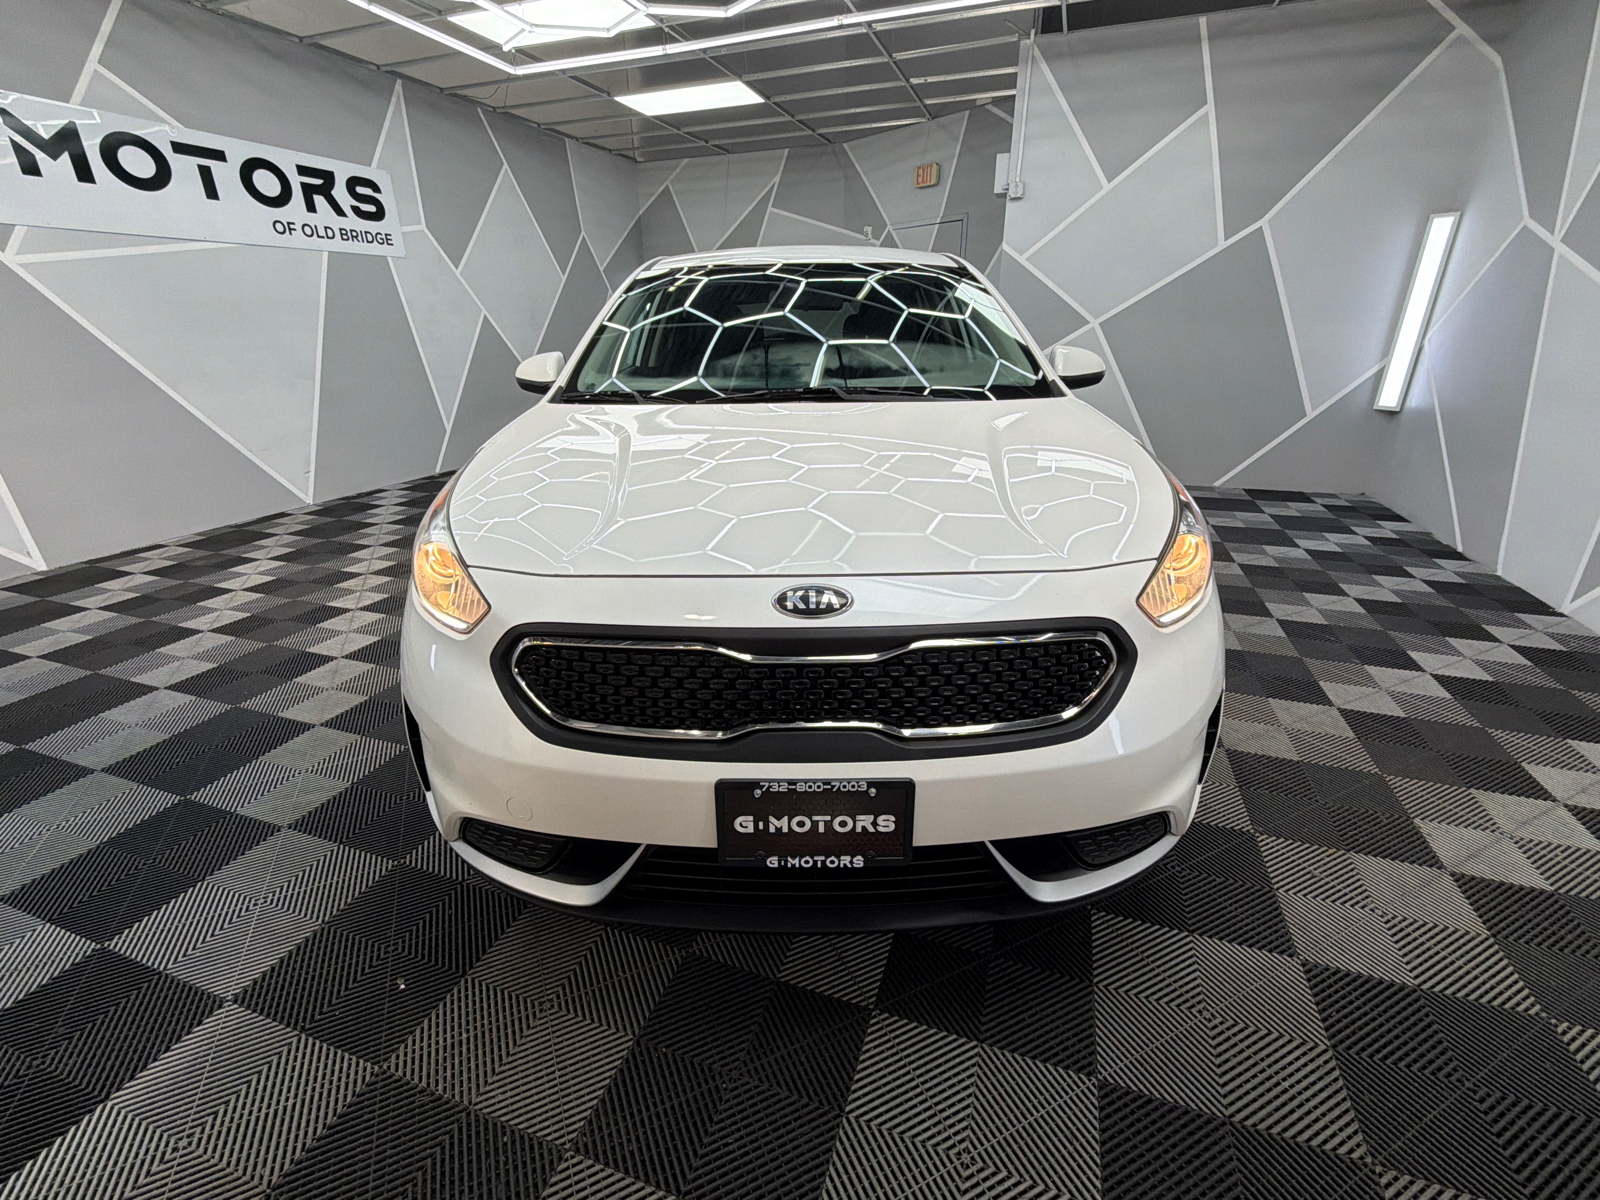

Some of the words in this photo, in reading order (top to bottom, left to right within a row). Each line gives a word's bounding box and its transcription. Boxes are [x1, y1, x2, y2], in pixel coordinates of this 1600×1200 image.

[0, 107, 387, 222] MOTORS
[916, 163, 934, 186] EXIT
[272, 219, 297, 236] OF
[301, 223, 336, 240] OLD
[338, 227, 395, 247] BRIDGE
[786, 589, 841, 610] KIA
[759, 781, 868, 792] 732-800-7003
